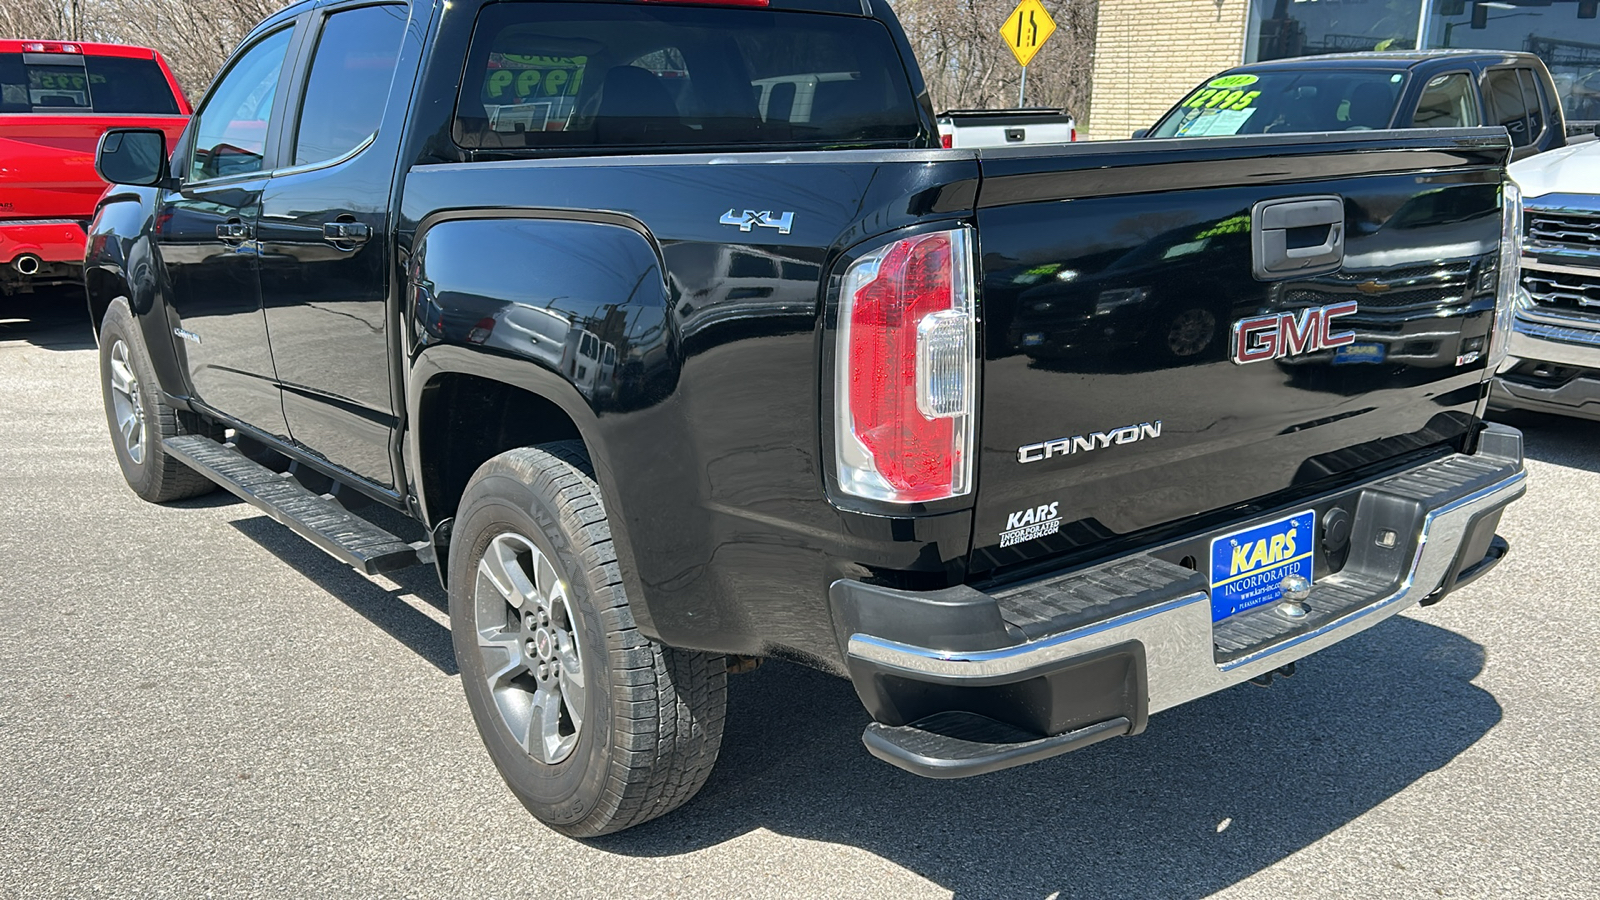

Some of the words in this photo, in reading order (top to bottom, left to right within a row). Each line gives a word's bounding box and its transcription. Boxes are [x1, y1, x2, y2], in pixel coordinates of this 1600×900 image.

[1181, 88, 1262, 111] 12995
[1229, 300, 1358, 365] GMC
[1017, 420, 1161, 463] CANYON
[1001, 520, 1060, 542] INCORPORATED
[1005, 501, 1059, 531] KARS
[1230, 528, 1297, 576] KARS
[1225, 562, 1300, 596] INCORPORATED
[1240, 582, 1280, 600] www.kars-inc.co
